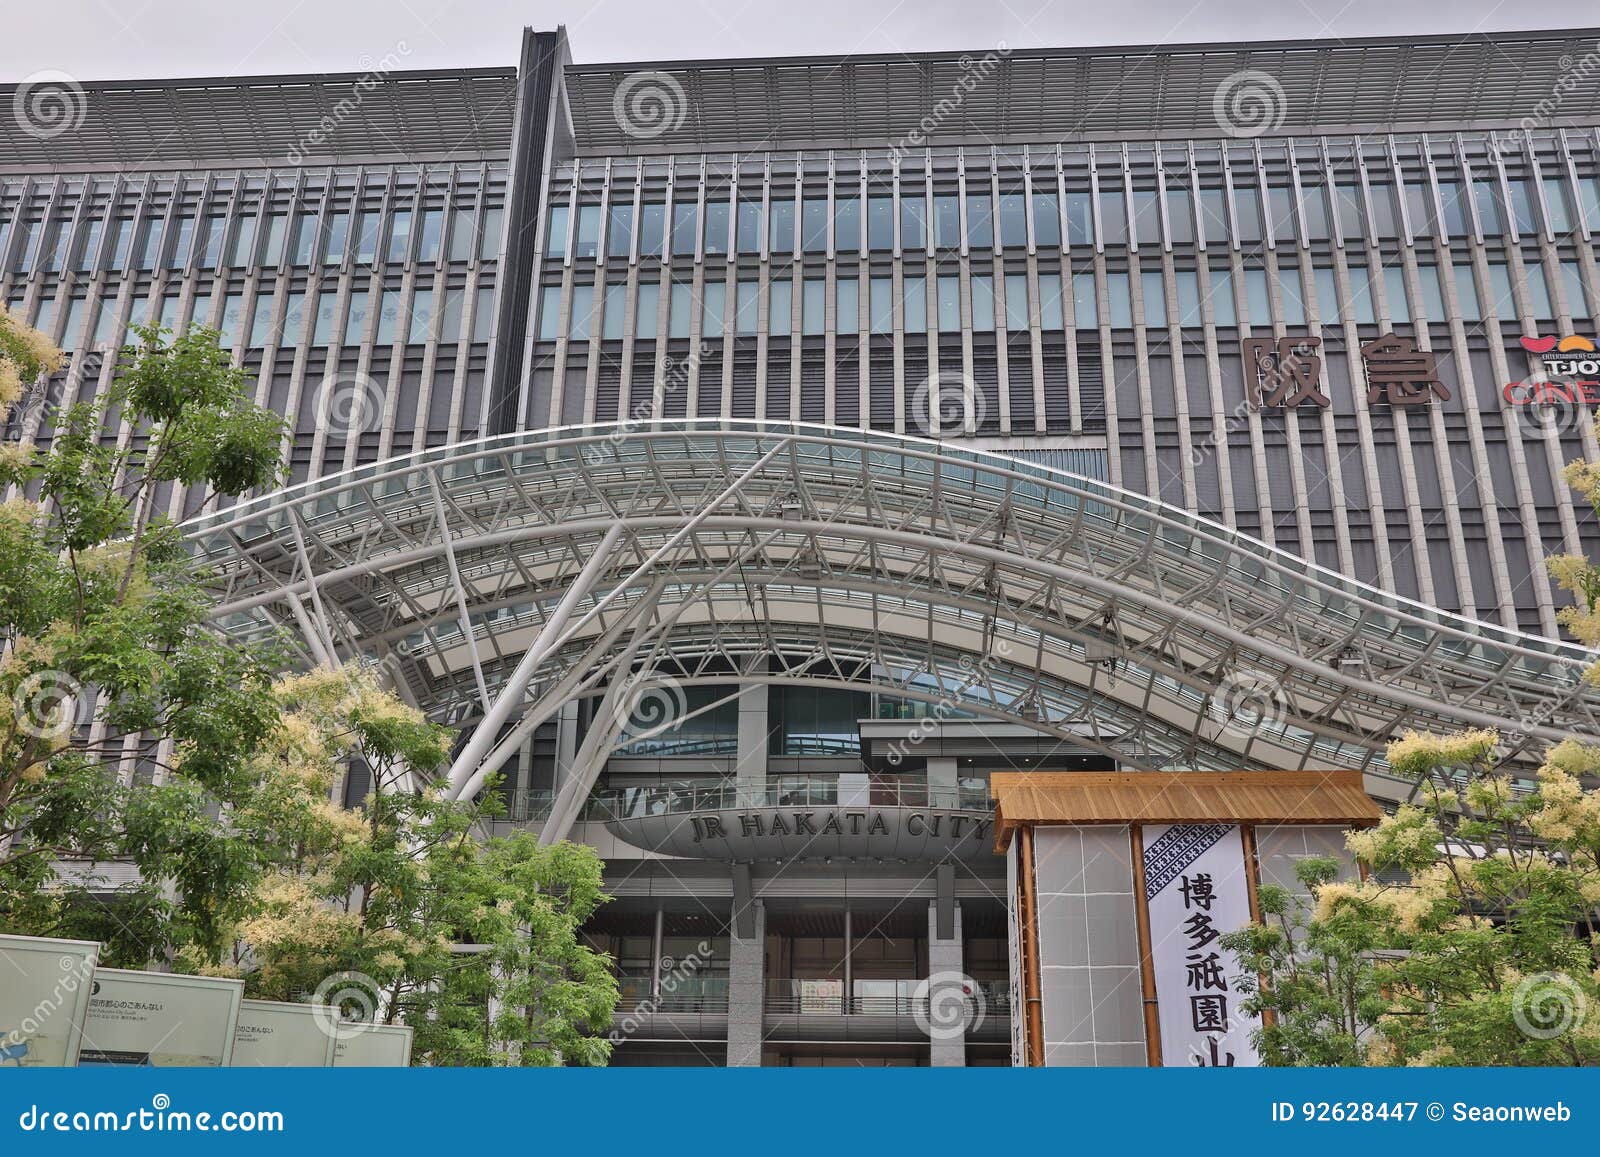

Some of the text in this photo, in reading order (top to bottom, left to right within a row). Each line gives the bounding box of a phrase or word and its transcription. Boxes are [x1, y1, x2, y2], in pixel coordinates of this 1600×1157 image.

[1242, 332, 1451, 411] 阪急
[689, 811, 995, 843] JR HAKATA CITY
